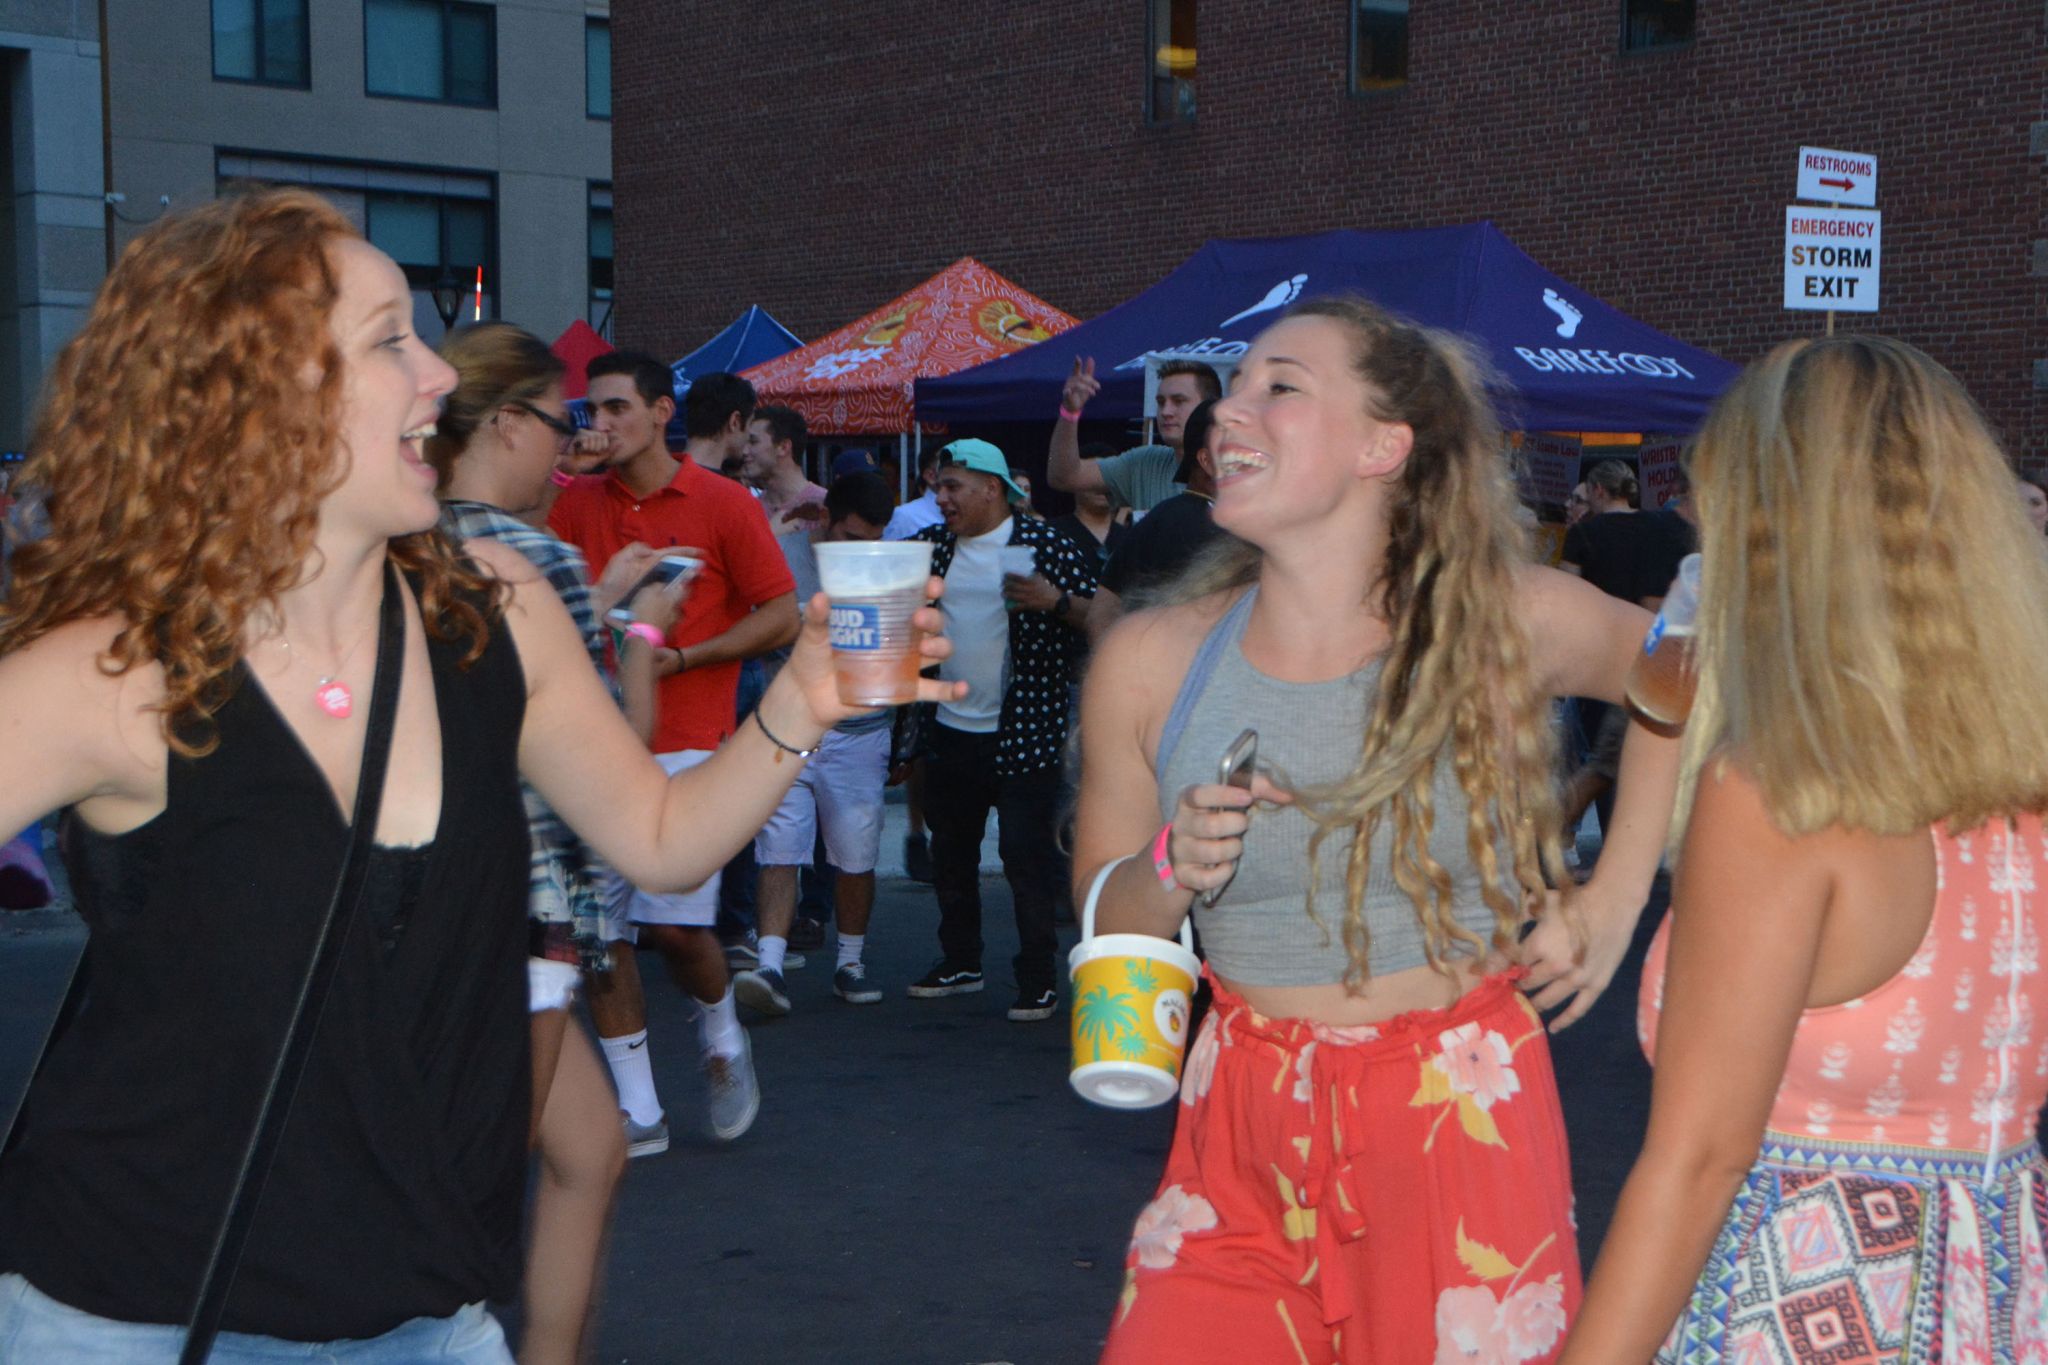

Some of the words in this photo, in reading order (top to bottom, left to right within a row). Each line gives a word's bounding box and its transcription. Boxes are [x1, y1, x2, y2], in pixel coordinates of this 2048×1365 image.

[1805, 154, 1872, 177] RESTROOMS
[1791, 217, 1875, 238] EMERGENCY
[1791, 244, 1872, 268] STORM
[1804, 275, 1859, 298] EXIT
[1514, 347, 1695, 380] BAREFOOT
